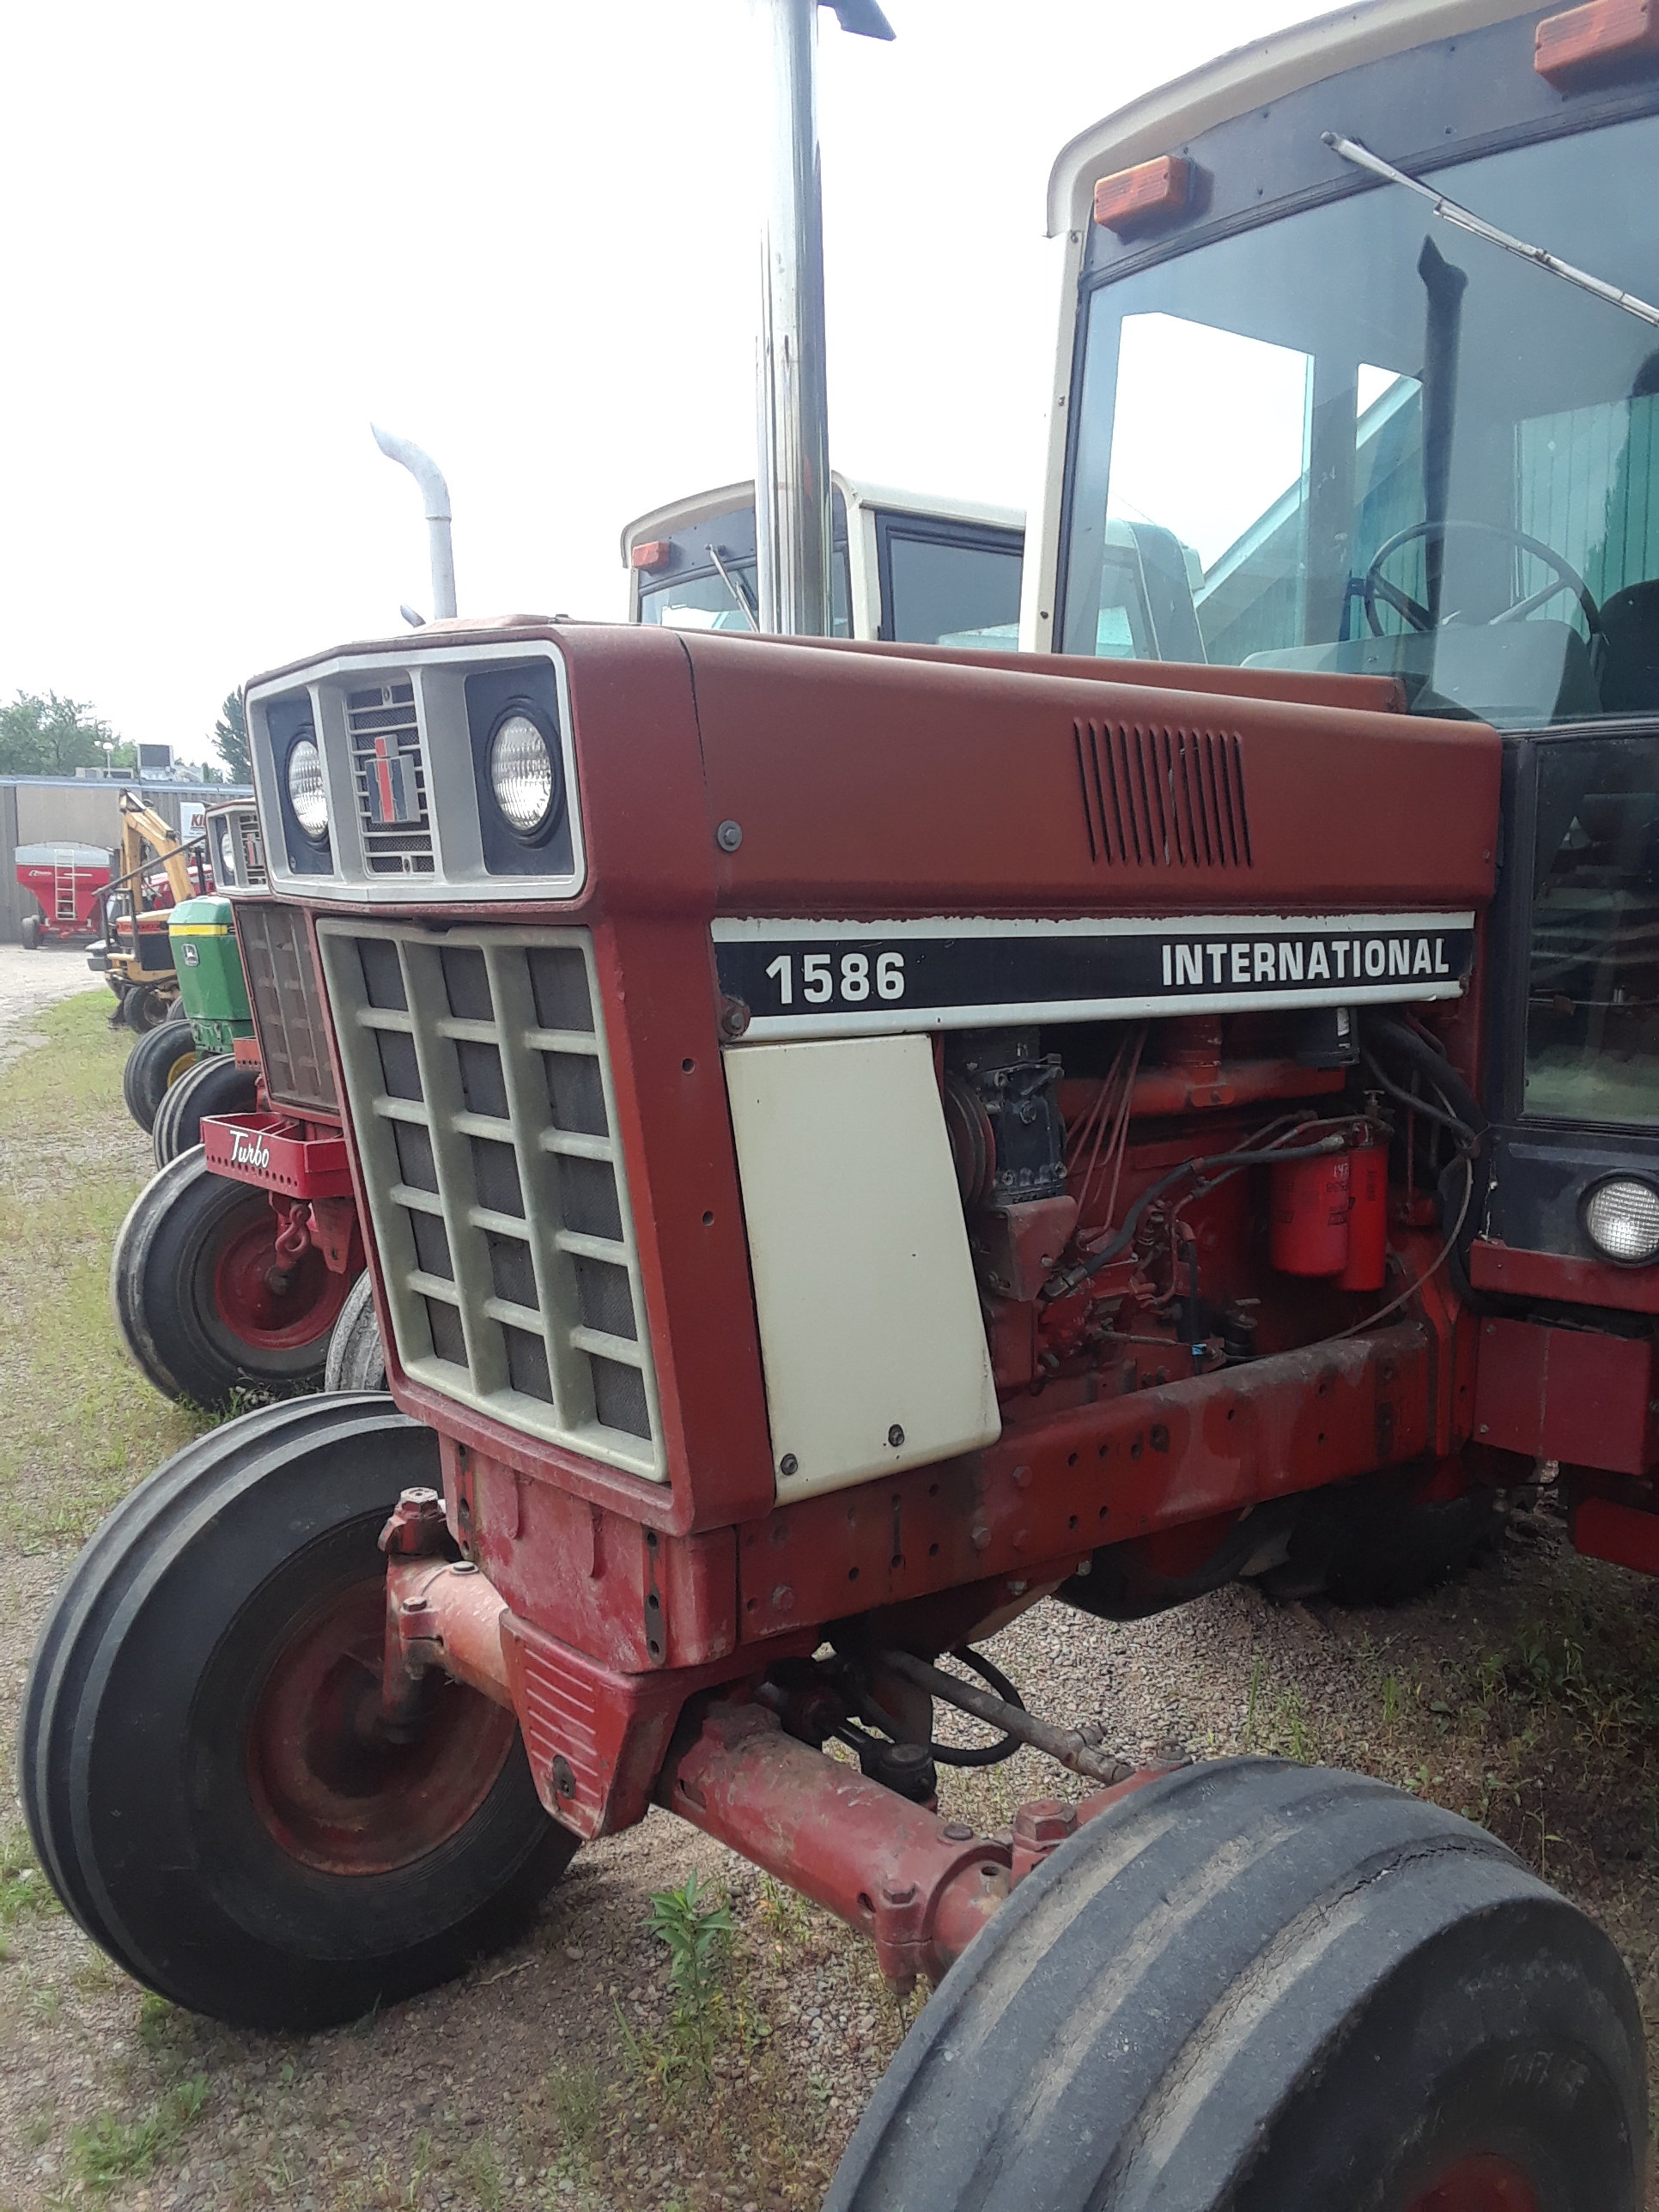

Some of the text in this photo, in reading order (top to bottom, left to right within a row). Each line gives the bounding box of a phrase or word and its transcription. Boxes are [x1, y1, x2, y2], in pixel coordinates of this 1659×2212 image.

[765, 939, 1449, 1004] 1586 INTERNATIONAL
[229, 1129, 270, 1168] Turbo
